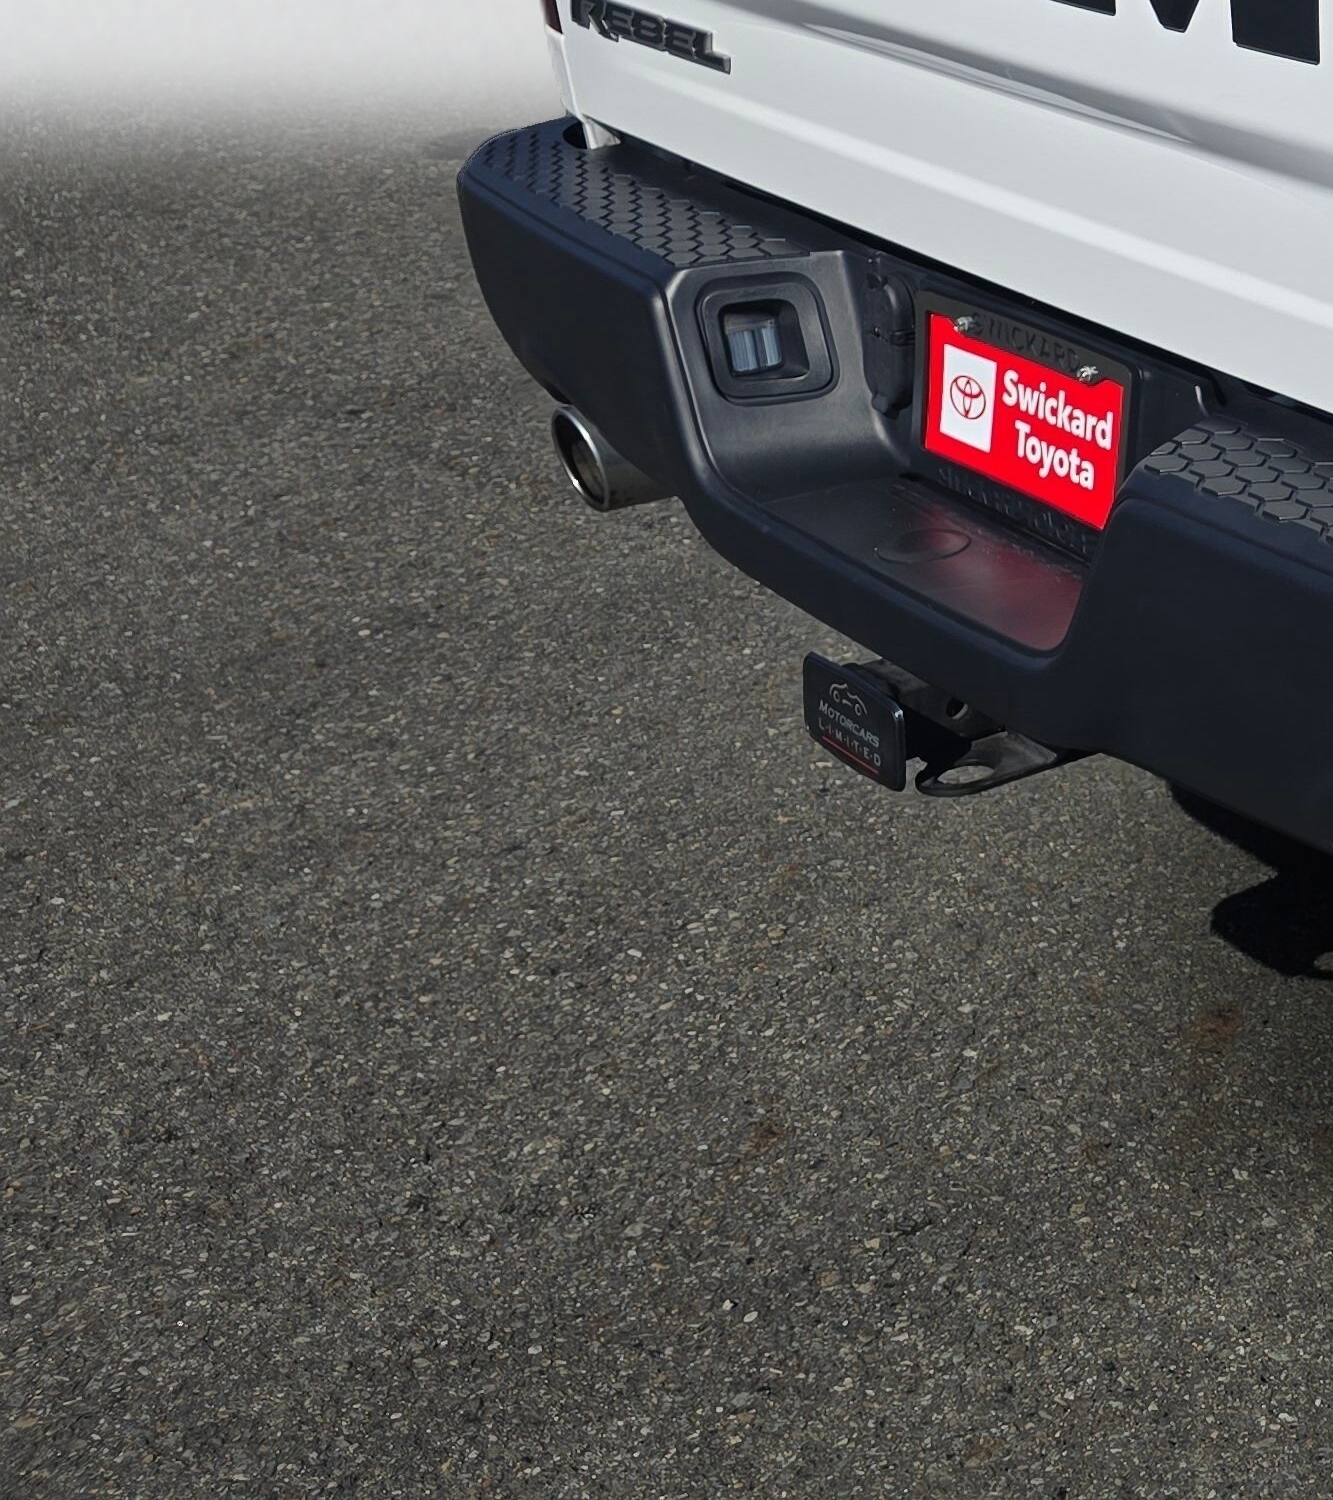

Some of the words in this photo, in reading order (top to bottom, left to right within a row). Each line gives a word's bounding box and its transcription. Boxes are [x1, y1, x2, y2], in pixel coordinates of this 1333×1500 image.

[1002, 369, 1114, 451] Swickard
[1014, 419, 1095, 491] Toyota
[819, 700, 880, 748] MOTORCARS
